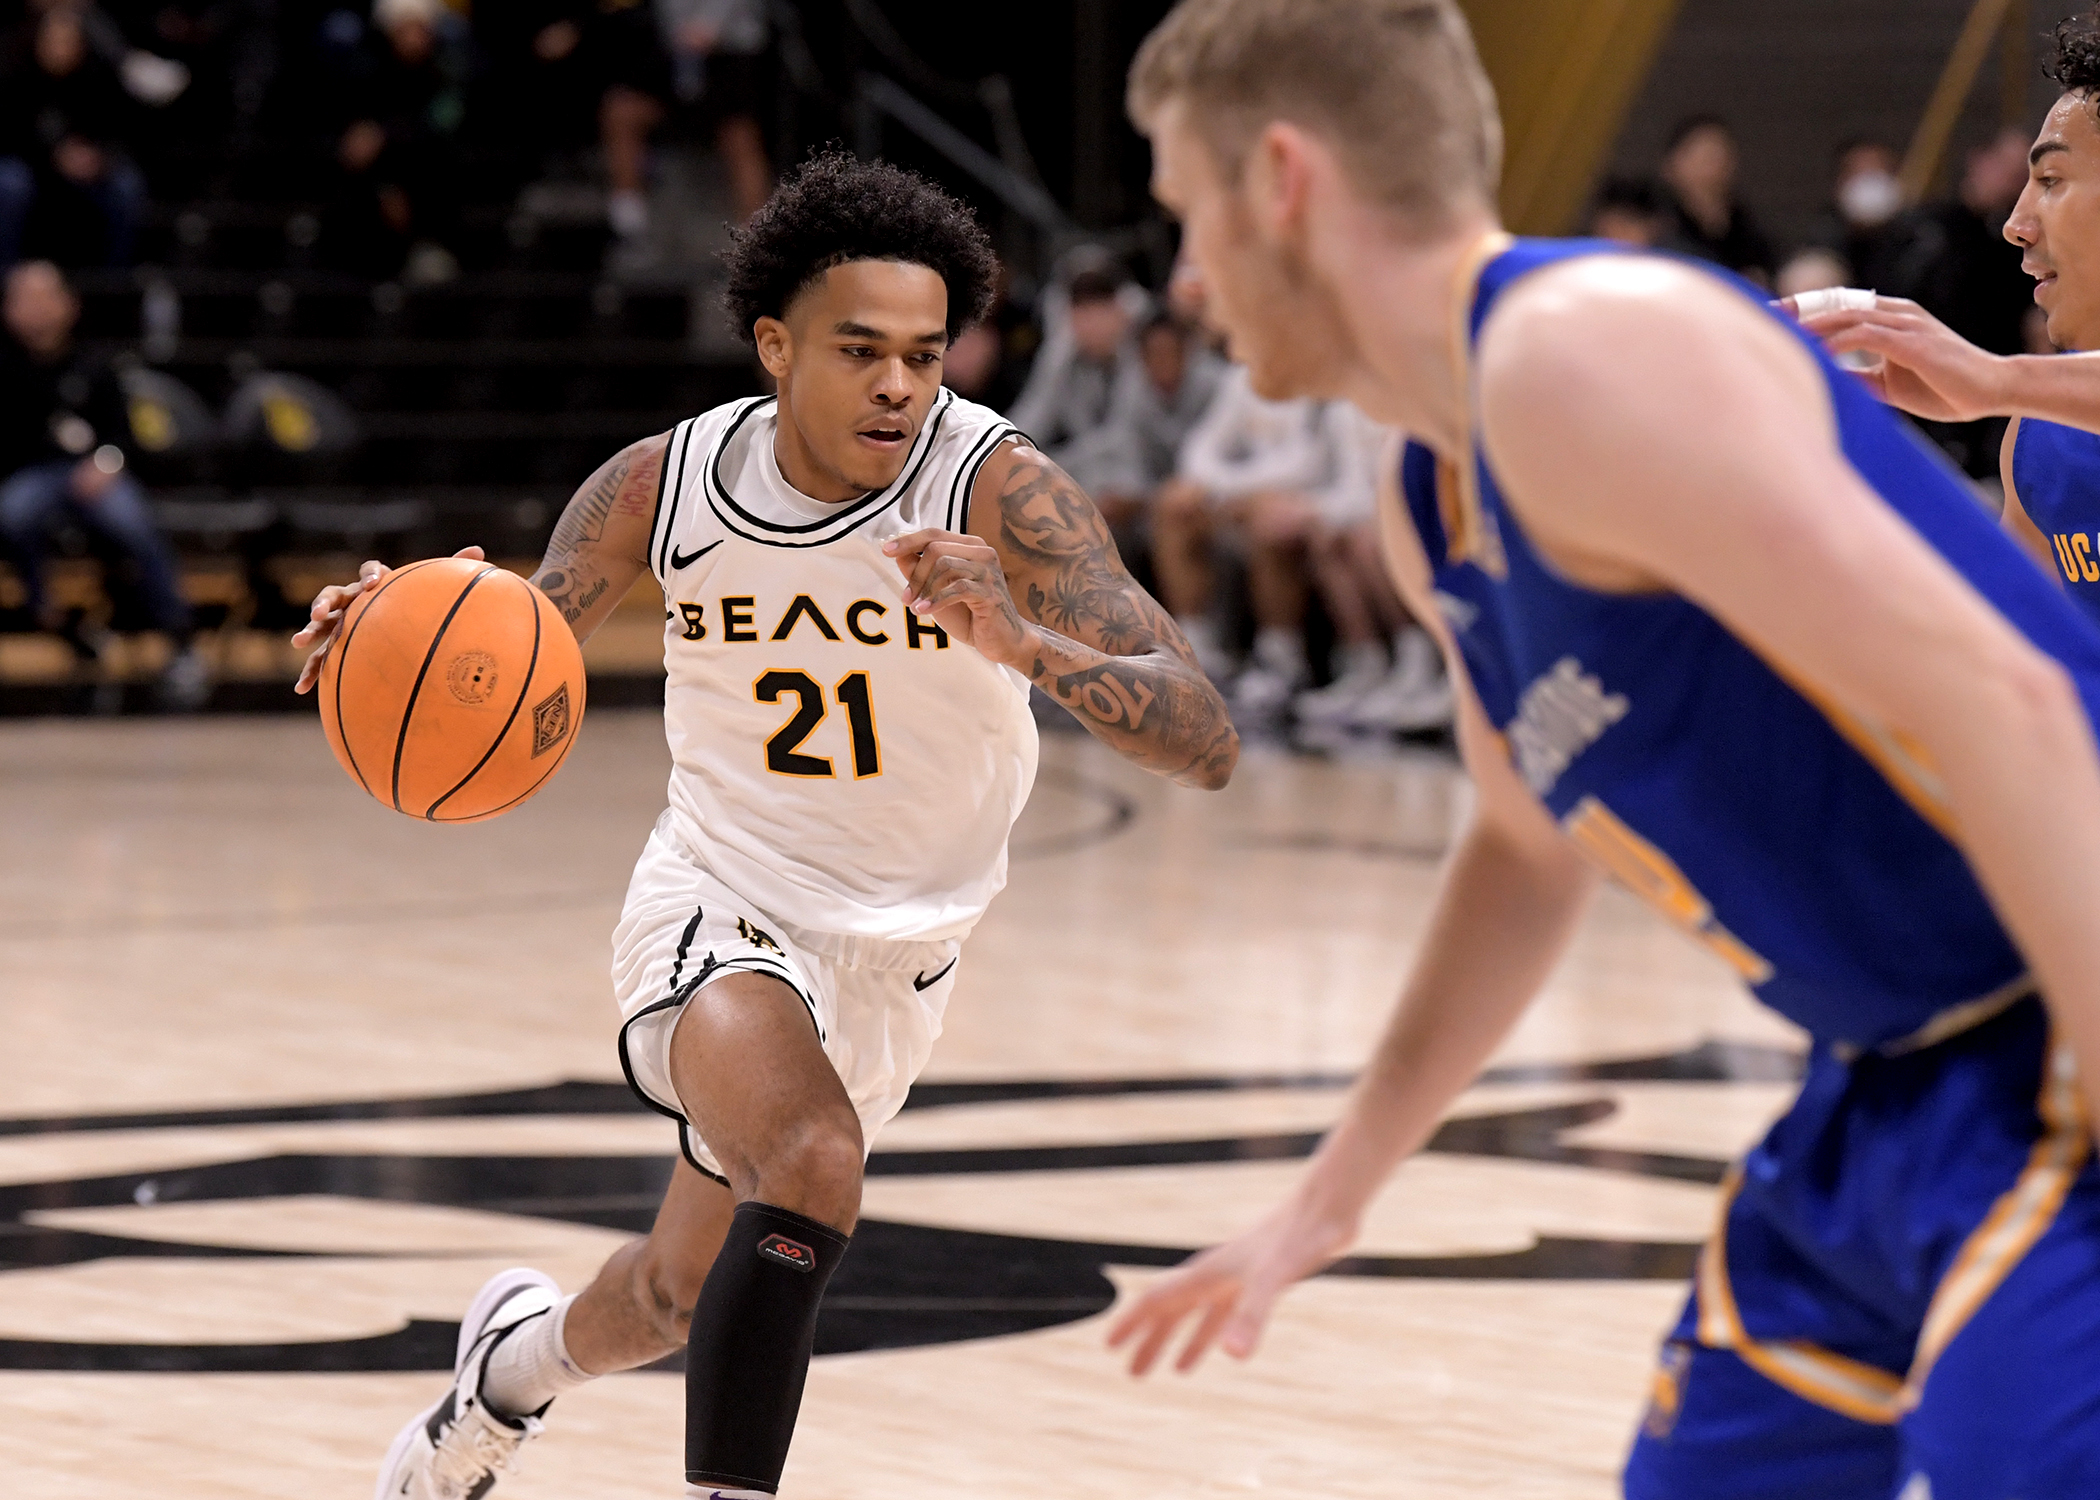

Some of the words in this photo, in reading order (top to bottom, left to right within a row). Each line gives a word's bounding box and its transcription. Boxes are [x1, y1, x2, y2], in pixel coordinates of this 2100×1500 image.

[2053, 532, 2100, 583] UC
[677, 593, 950, 650] BEACH
[751, 667, 883, 781] 21
